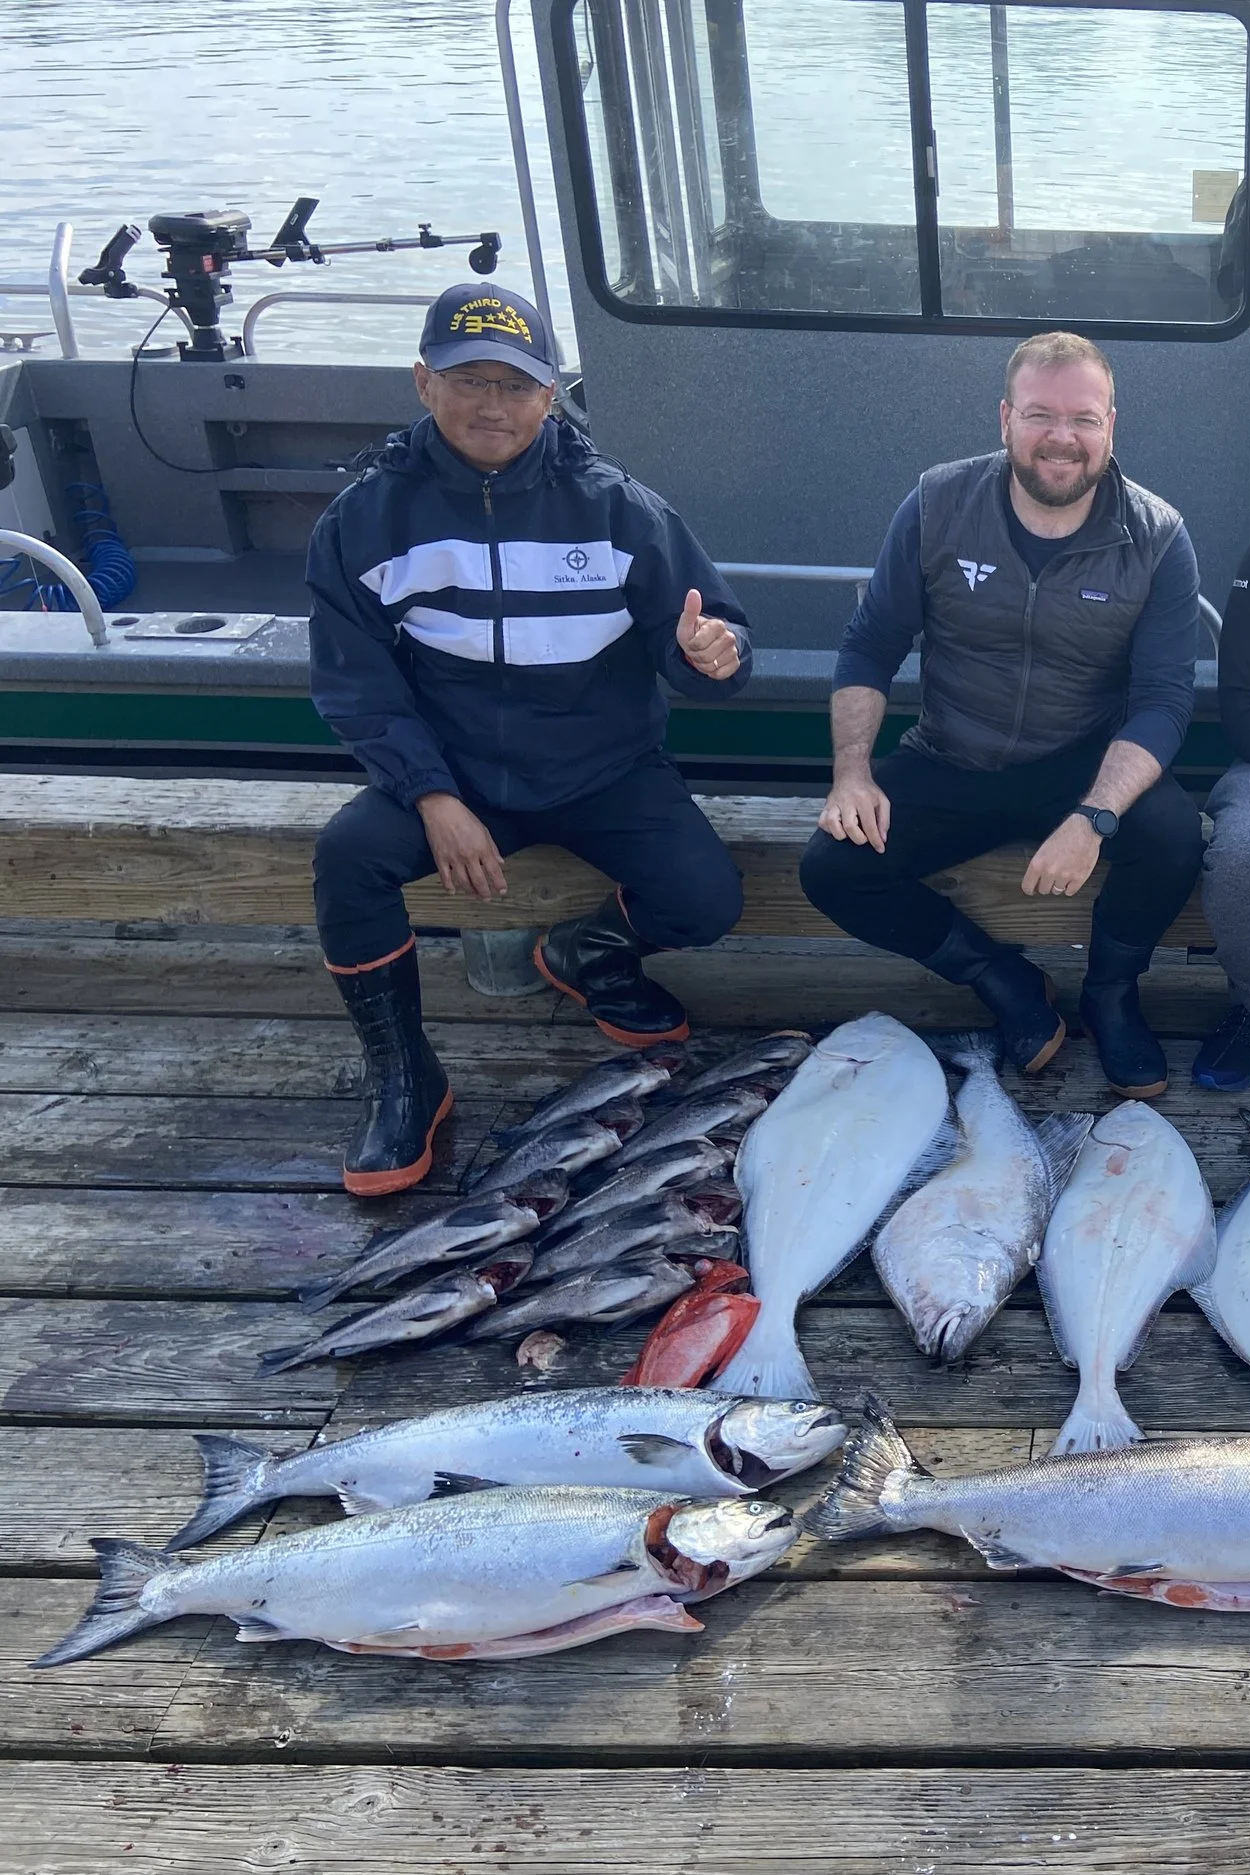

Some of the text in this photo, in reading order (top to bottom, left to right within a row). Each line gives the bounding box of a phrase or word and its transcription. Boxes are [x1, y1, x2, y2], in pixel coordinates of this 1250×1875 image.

[460, 298, 502, 313] THIRD
[504, 305, 533, 344] FLEET
[580, 573, 607, 583] Alaska
